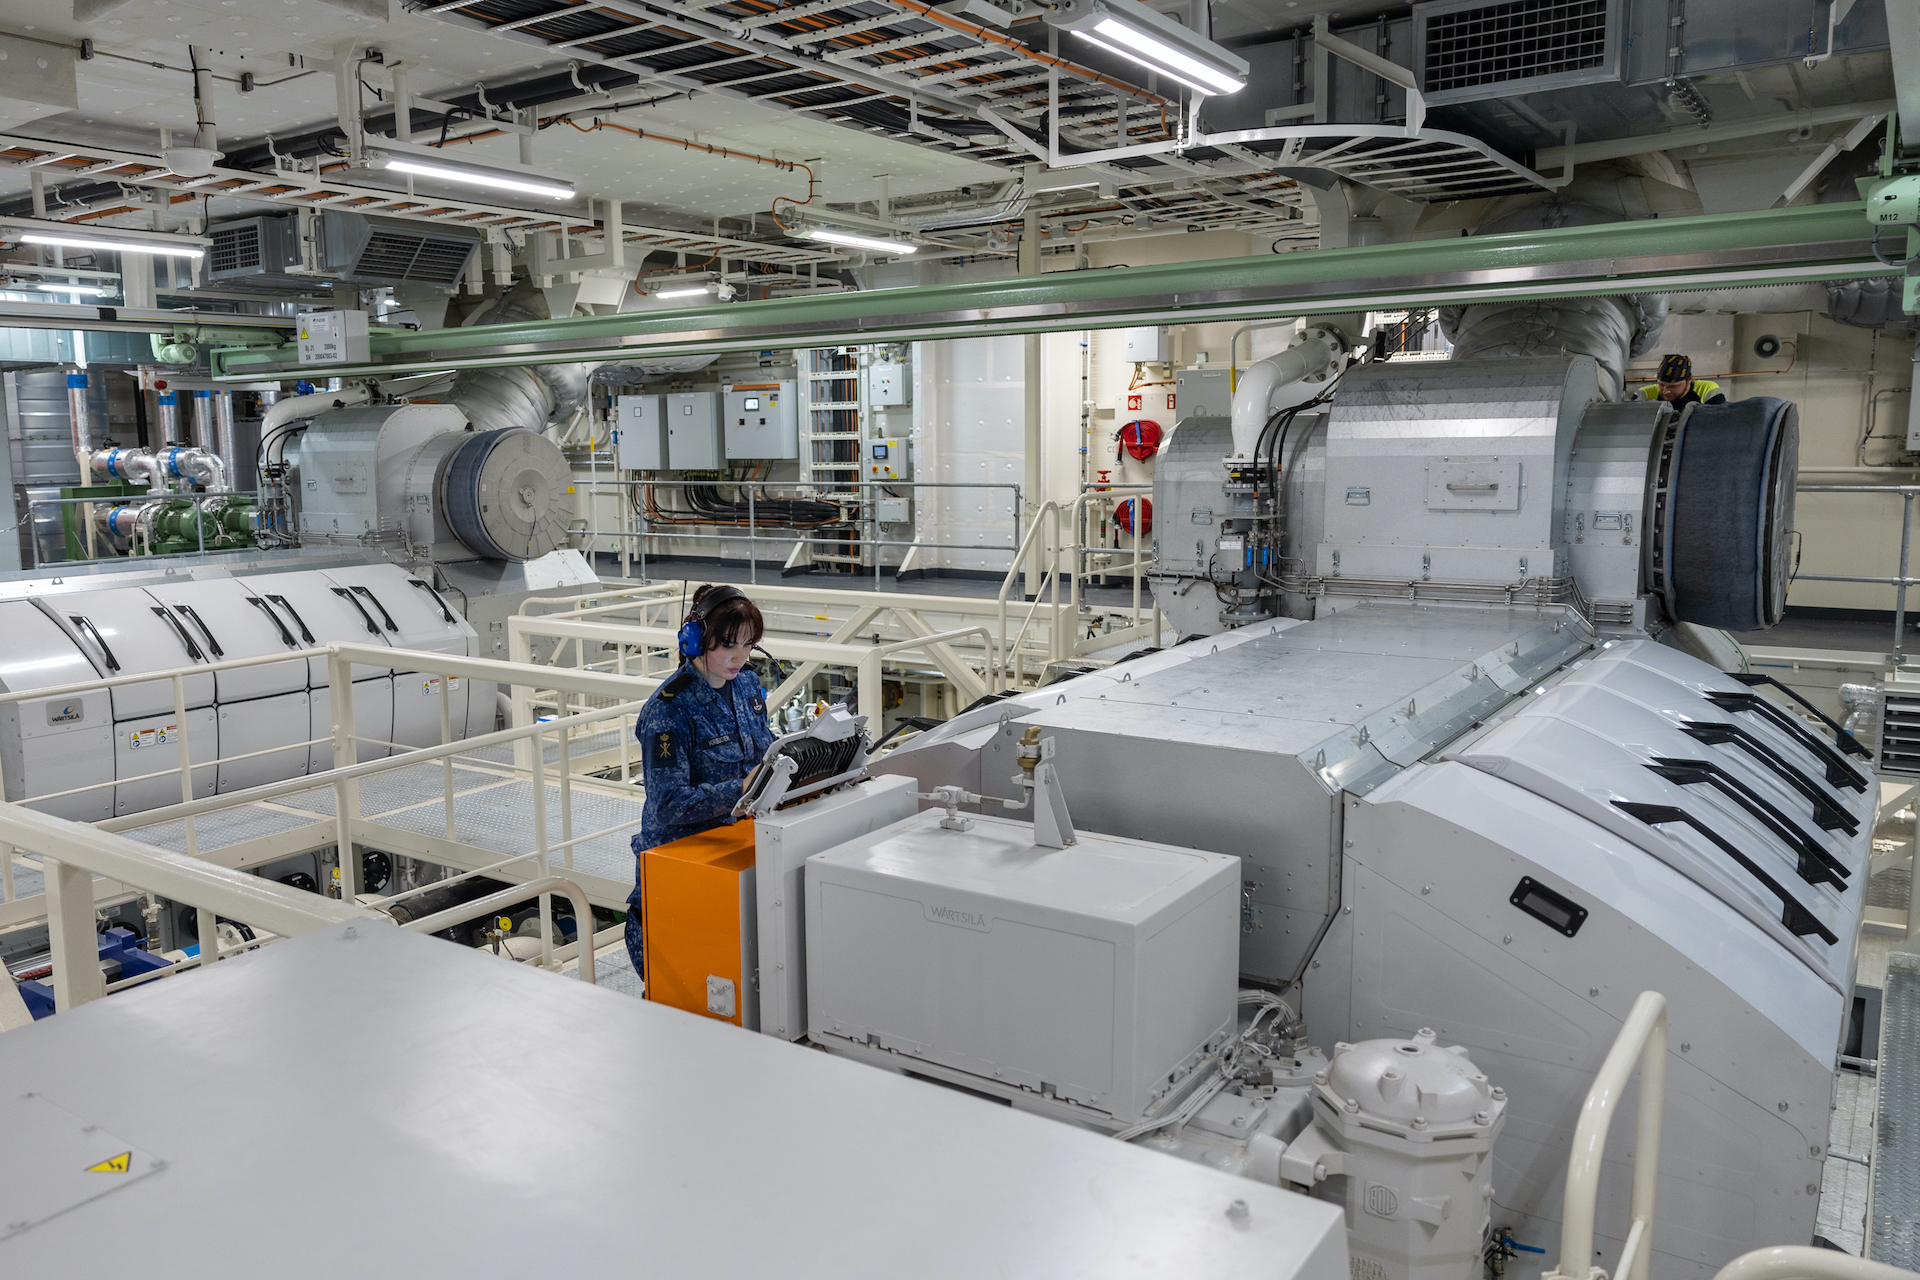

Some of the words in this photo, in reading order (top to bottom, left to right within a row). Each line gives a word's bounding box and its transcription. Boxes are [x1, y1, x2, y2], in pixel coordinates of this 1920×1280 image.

[1880, 213, 1899, 222] M12
[51, 712, 80, 723] WÄRTSILÄ
[930, 905, 986, 928] WÄRTSILÄ
